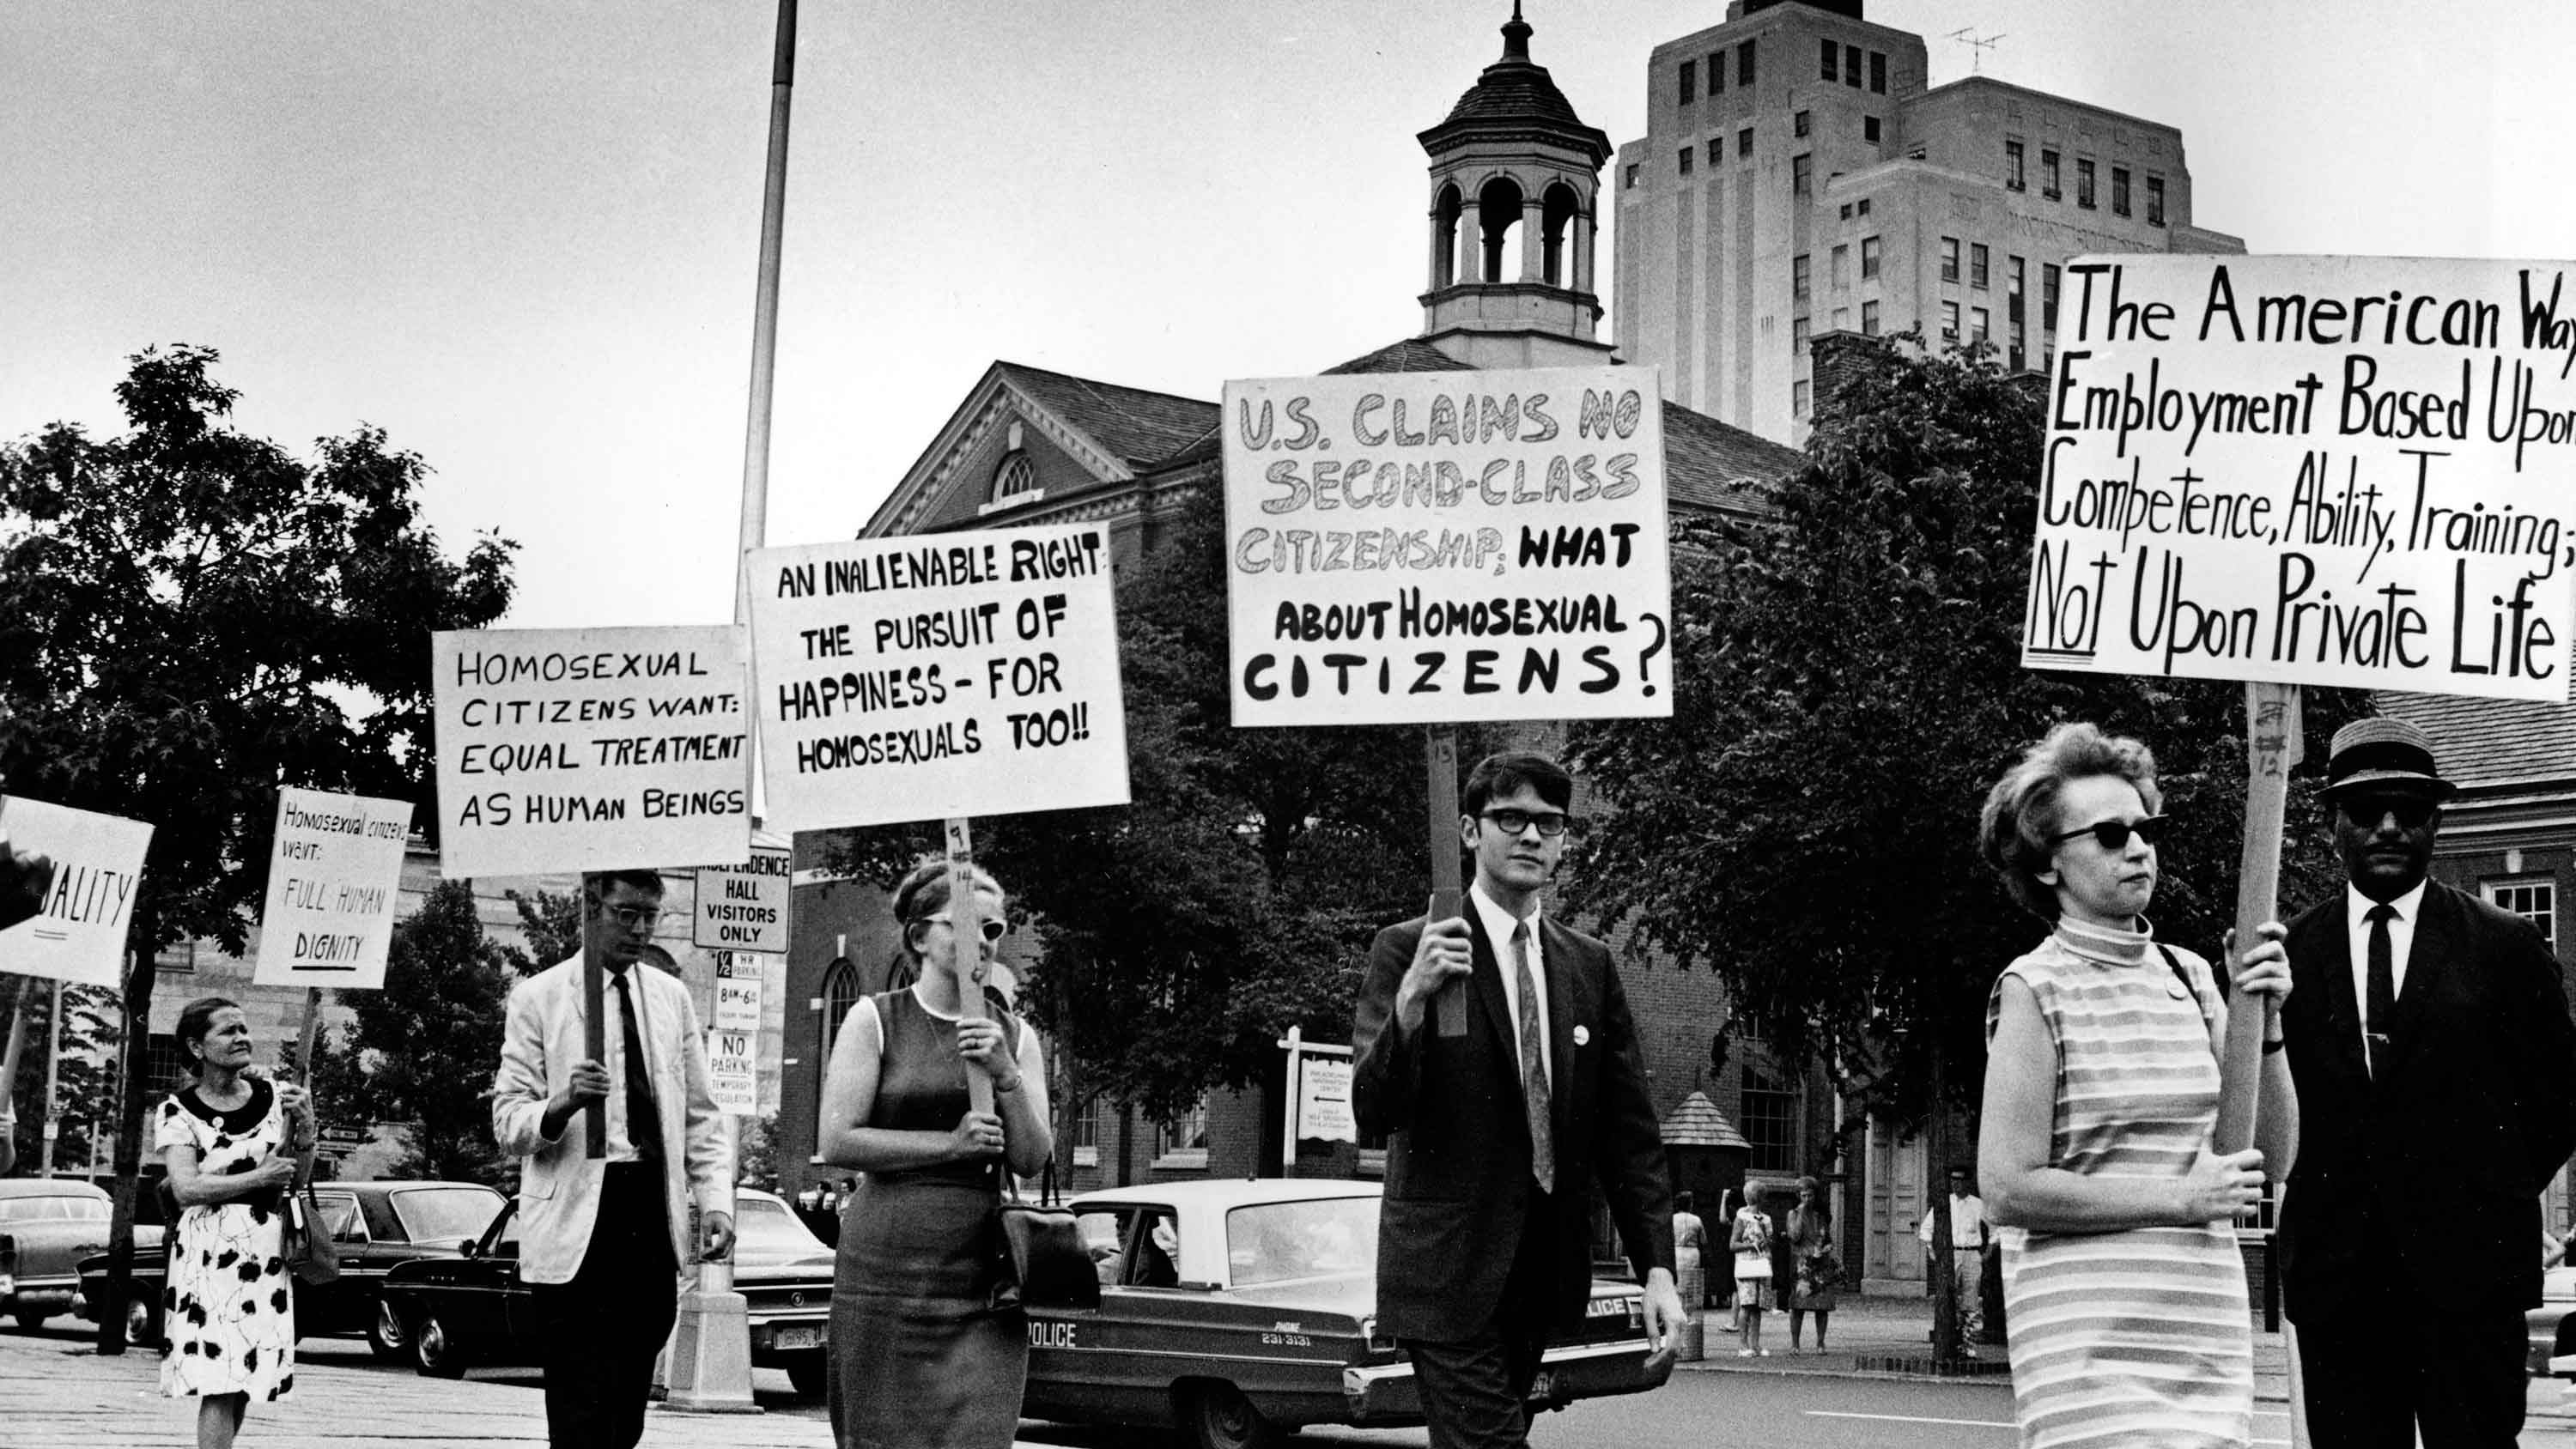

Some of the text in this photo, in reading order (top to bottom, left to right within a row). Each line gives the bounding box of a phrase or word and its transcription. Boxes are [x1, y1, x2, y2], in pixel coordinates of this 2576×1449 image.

[2069, 264, 2576, 379] The American Way
[1240, 388, 1641, 451] U.S. CLAIMS NO
[2054, 350, 2323, 458] Employment
[2339, 355, 2470, 440] Based
[1261, 453, 1640, 514] SECOND-CLASS
[2044, 436, 2576, 585] Competence, Ability, Training;
[778, 563, 815, 597] AN
[825, 545, 999, 596] INALIENABLE
[1236, 523, 1640, 576] CITIZENSHIP; WHAT
[801, 594, 1066, 659] THE PURSUIT OF
[1275, 586, 1628, 641] ABOUT HOMOSEXUAL
[2029, 539, 2554, 680] Not Upon Private Life
[458, 652, 708, 687] HOMOSEXUAL
[988, 652, 1061, 699] FOR
[1244, 613, 1665, 700] CITIZENS?
[462, 694, 738, 726] CITIZENS WANT:
[460, 735, 745, 775] EQUAL TREATMENT
[799, 702, 1089, 773] HOMOSEXUALS TOO!!
[283, 802, 367, 835] Homosexual
[459, 789, 744, 826] AS HUMAN BEINGS
[698, 855, 789, 876] NDENCE
[39, 861, 132, 927] UALITY
[284, 878, 386, 913] FULL HUMAN
[726, 879, 759, 900] HALL
[707, 904, 776, 923] VISITORS
[720, 925, 762, 943] ONLY
[295, 932, 364, 961] DIGNITY
[722, 1037, 745, 1056] NO
[1587, 1298, 1626, 1318] LICE
